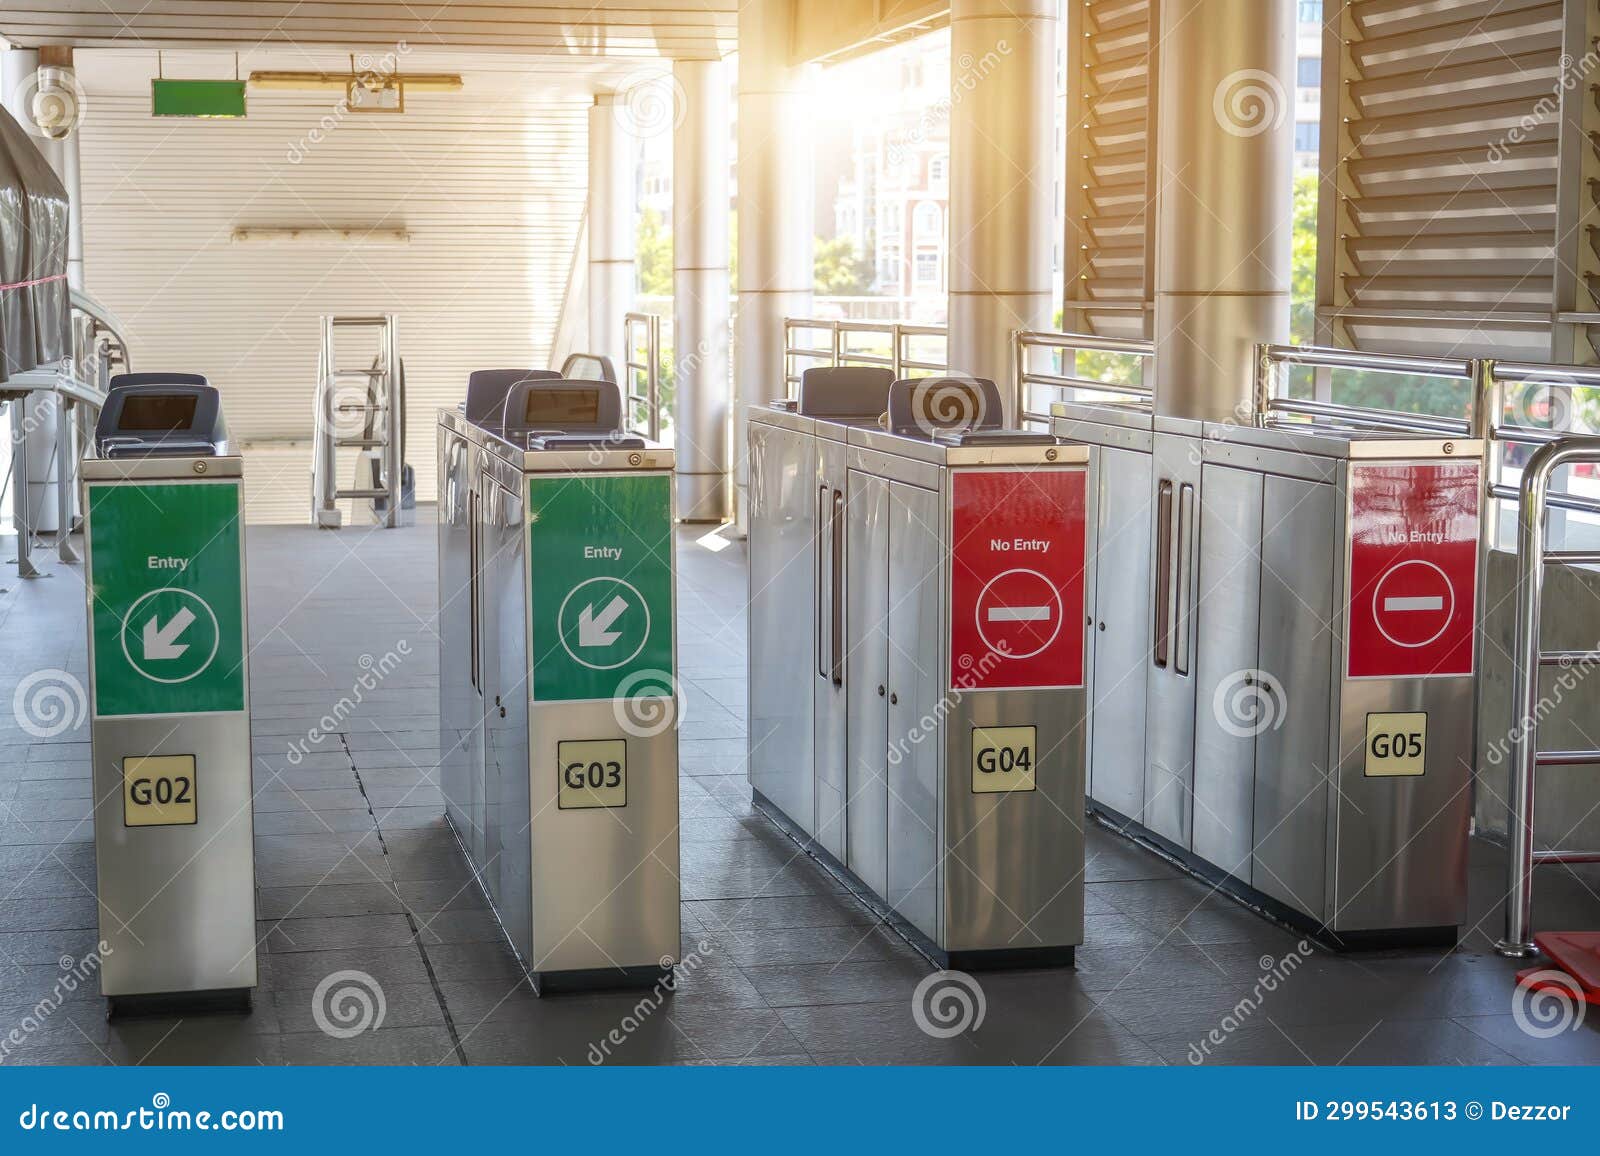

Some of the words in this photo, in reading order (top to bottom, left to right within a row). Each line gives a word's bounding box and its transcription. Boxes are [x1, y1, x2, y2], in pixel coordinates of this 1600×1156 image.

[990, 538, 1010, 551] No
[1013, 538, 1050, 553] Entry
[1410, 530, 1443, 545] Entry
[584, 546, 622, 560] Entry
[147, 556, 188, 571] Entry
[1371, 733, 1422, 759] G05
[977, 746, 1031, 773] G04
[564, 761, 622, 789] G03
[130, 776, 191, 805] G02
